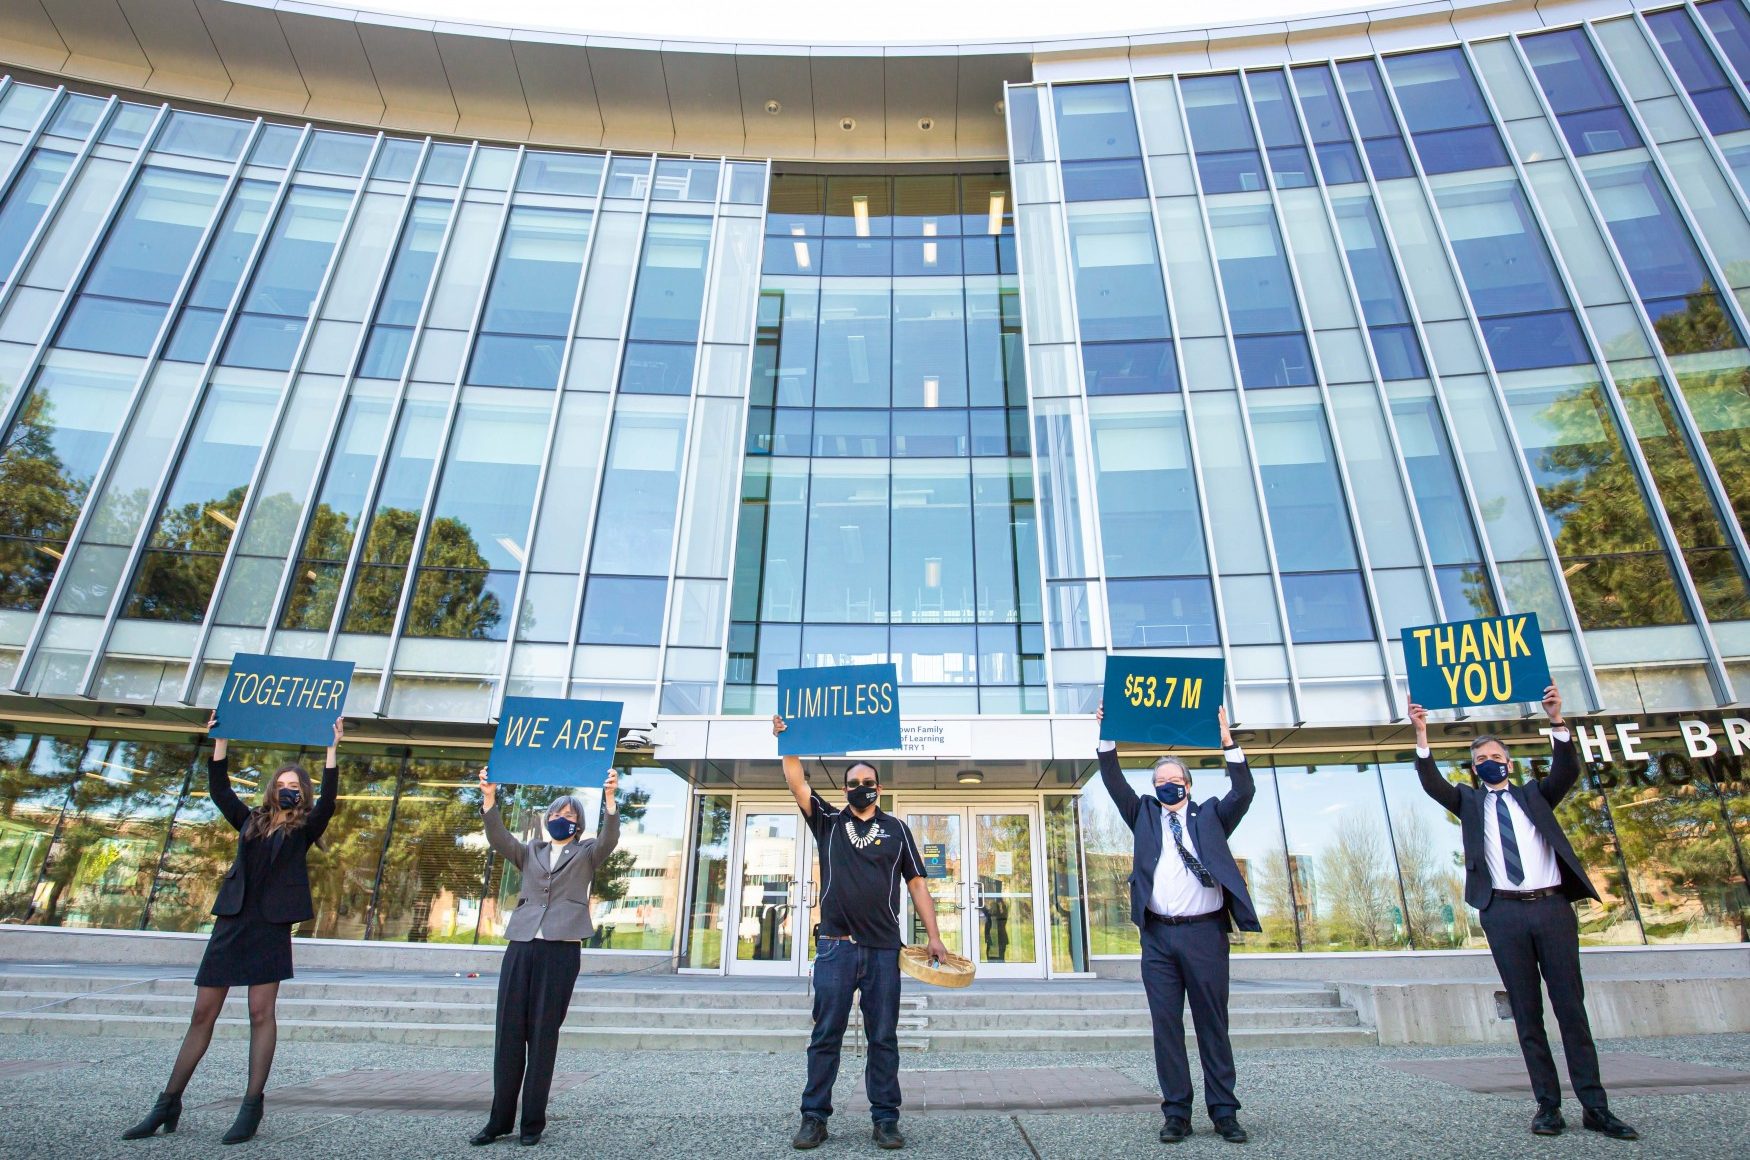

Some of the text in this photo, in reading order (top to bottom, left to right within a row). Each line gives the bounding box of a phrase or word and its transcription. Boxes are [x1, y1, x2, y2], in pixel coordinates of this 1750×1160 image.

[1412, 616, 1532, 668] THANK
[229, 672, 345, 710] TOGETHER
[785, 682, 893, 719] LIMITLESS
[1124, 673, 1203, 709] $53.7 M
[1441, 660, 1512, 705] YOU
[504, 716, 613, 751] WE ARE
[909, 735, 944, 743] Learning
[917, 726, 944, 734] Family
